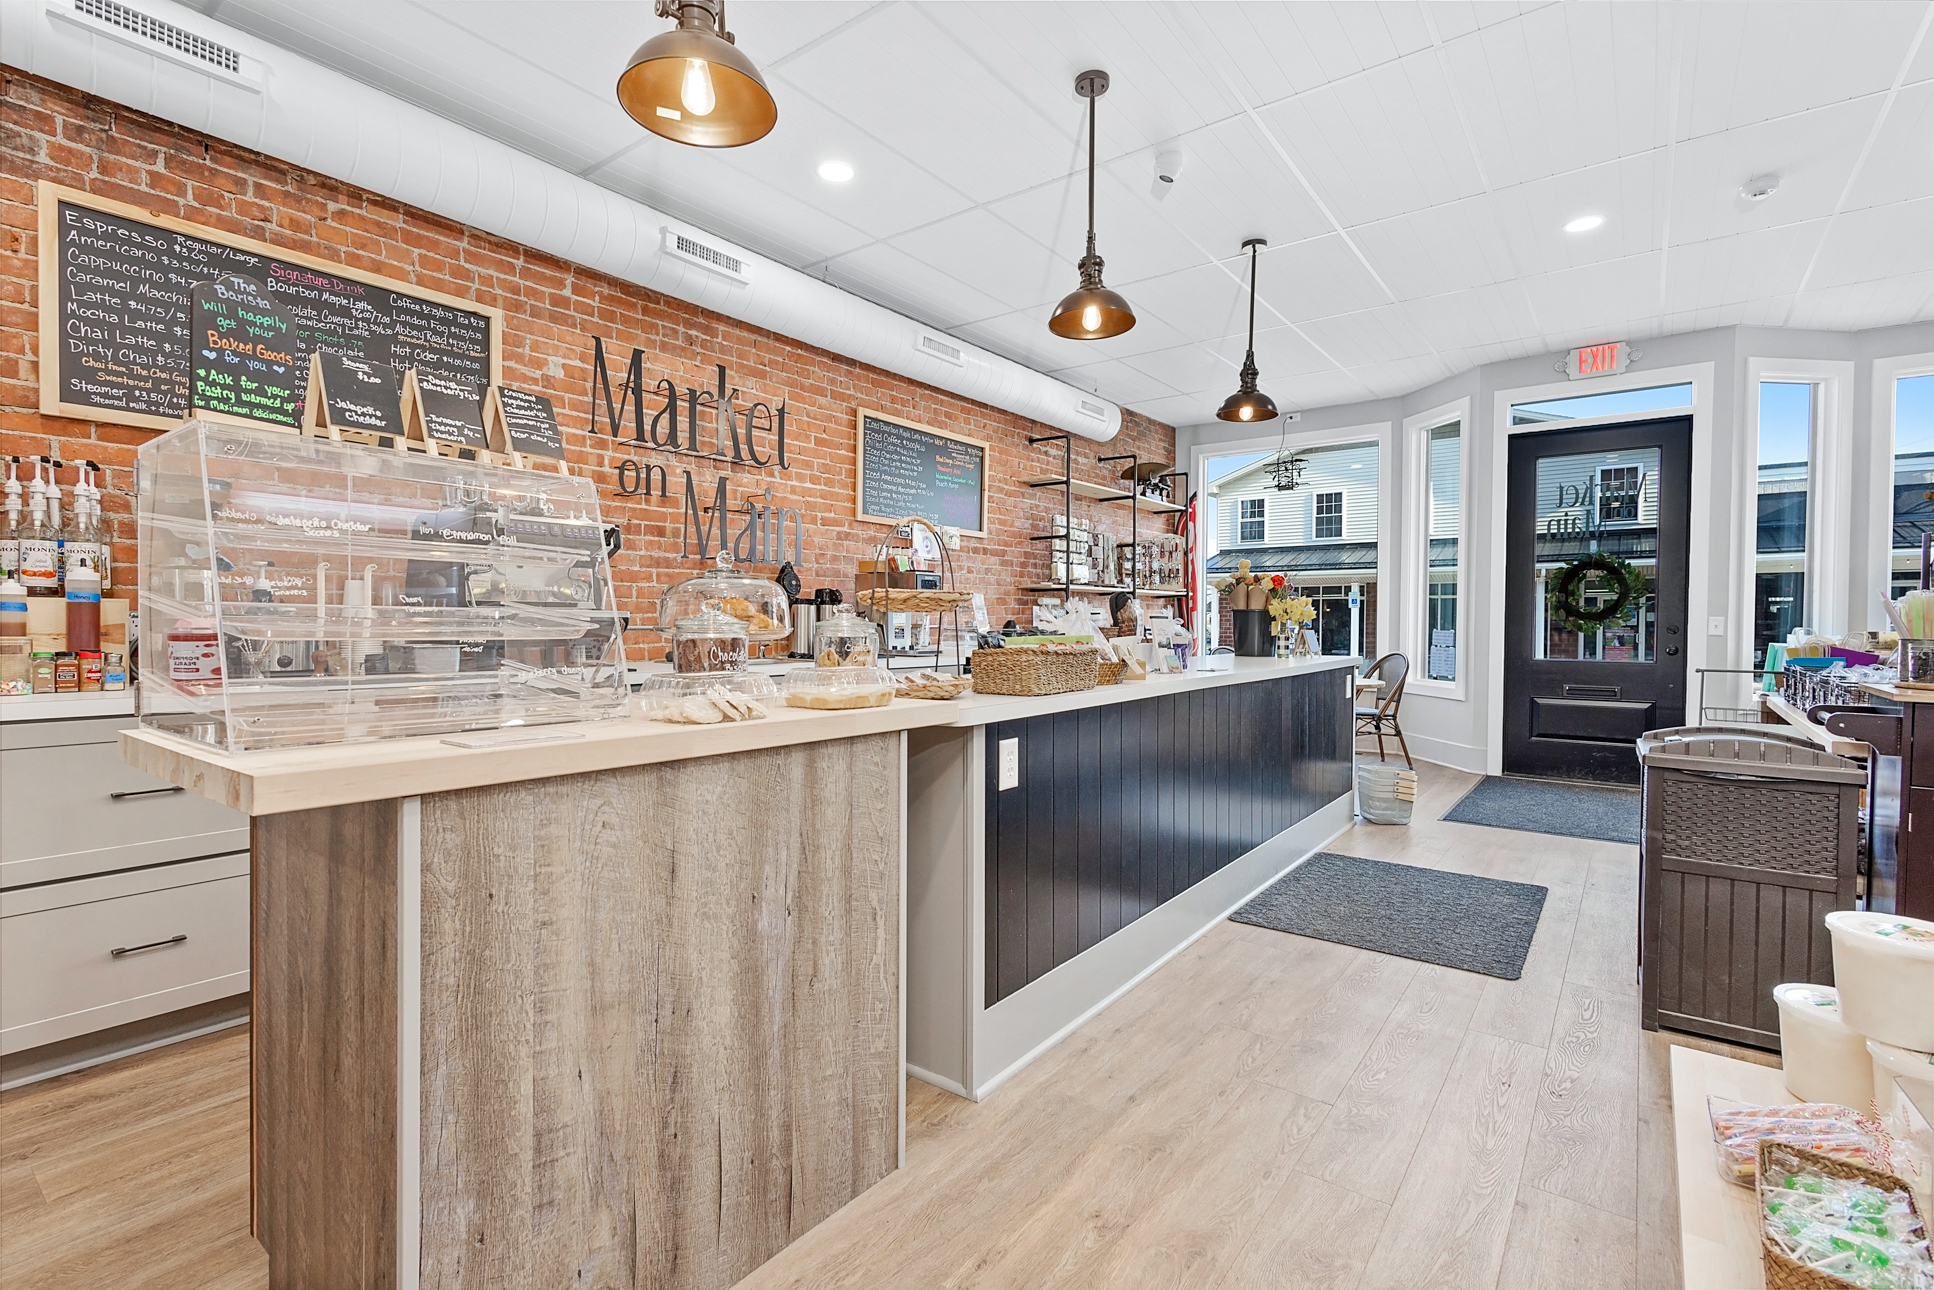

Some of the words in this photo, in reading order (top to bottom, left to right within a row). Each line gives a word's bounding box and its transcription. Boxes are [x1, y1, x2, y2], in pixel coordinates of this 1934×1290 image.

[65, 210, 167, 249] Espresso
[66, 230, 158, 262] Americano
[67, 247, 164, 282] Cappuccino
[168, 273, 198, 288] $4.7
[66, 266, 130, 292] Caramel
[229, 276, 257, 294] The
[270, 263, 331, 287] Signature
[331, 279, 365, 295] Drink
[70, 284, 122, 308] Latte
[128, 300, 190, 321] $4.75/5.
[213, 284, 271, 310] Barista
[267, 278, 318, 299] Bourbon
[321, 292, 349, 308] Maple
[350, 298, 374, 311] Latte
[67, 301, 119, 323] Mocha
[125, 314, 166, 333] Latte
[201, 299, 227, 315] Will
[238, 307, 287, 333] happily
[321, 310, 355, 327] Covered
[390, 294, 421, 311] Coffee
[454, 311, 469, 324] Tea
[216, 317, 237, 332] get
[246, 325, 276, 337] your
[295, 317, 342, 335] rawberry
[345, 326, 371, 338] Latte
[393, 309, 429, 328] London
[430, 320, 448, 335] Fog
[67, 319, 109, 339] Chai
[116, 329, 157, 350] Latte
[314, 332, 345, 345] Shots
[393, 323, 425, 341] Abbey
[424, 331, 447, 346] Road
[68, 339, 113, 361] Dirty
[119, 349, 152, 365] Chai
[207, 330, 253, 355] Baked
[256, 344, 293, 366] Goods
[316, 343, 364, 358] Chocolate
[391, 344, 411, 356] Hot
[414, 349, 440, 362] Cider
[1578, 344, 1620, 374] EXIT
[82, 357, 105, 369] Chai
[107, 361, 128, 374] from
[129, 364, 149, 376] The
[150, 368, 170, 379] Chai
[224, 350, 240, 364] for
[246, 360, 267, 372] you
[390, 358, 411, 371] Hot
[70, 378, 128, 397] Steamer
[96, 372, 152, 388] Sweetened
[208, 369, 234, 385] Ask
[240, 376, 259, 389] for
[265, 385, 290, 397] your
[357, 371, 382, 384] $3.00
[428, 375, 459, 389] Danish
[90, 395, 127, 407] Steamed
[129, 401, 149, 411] milk
[157, 405, 183, 415] flavo
[194, 395, 205, 406] for
[196, 381, 236, 403] Pastry
[241, 392, 281, 407] warmed
[283, 402, 295, 413] up
[504, 389, 537, 402] Croissant
[588, 335, 790, 470] Market
[345, 411, 387, 427] Cheddar
[429, 414, 465, 427] Turnover
[506, 417, 537, 426] Cinnamon
[865, 430, 882, 441] Iced
[883, 433, 902, 446] Coffee
[618, 459, 668, 498] on
[865, 470, 880, 478] Iced
[881, 473, 906, 484] Americano
[865, 488, 878, 497] Iced
[330, 519, 373, 532] Cheddar
[681, 470, 803, 567] Main
[304, 527, 341, 538] Scones
